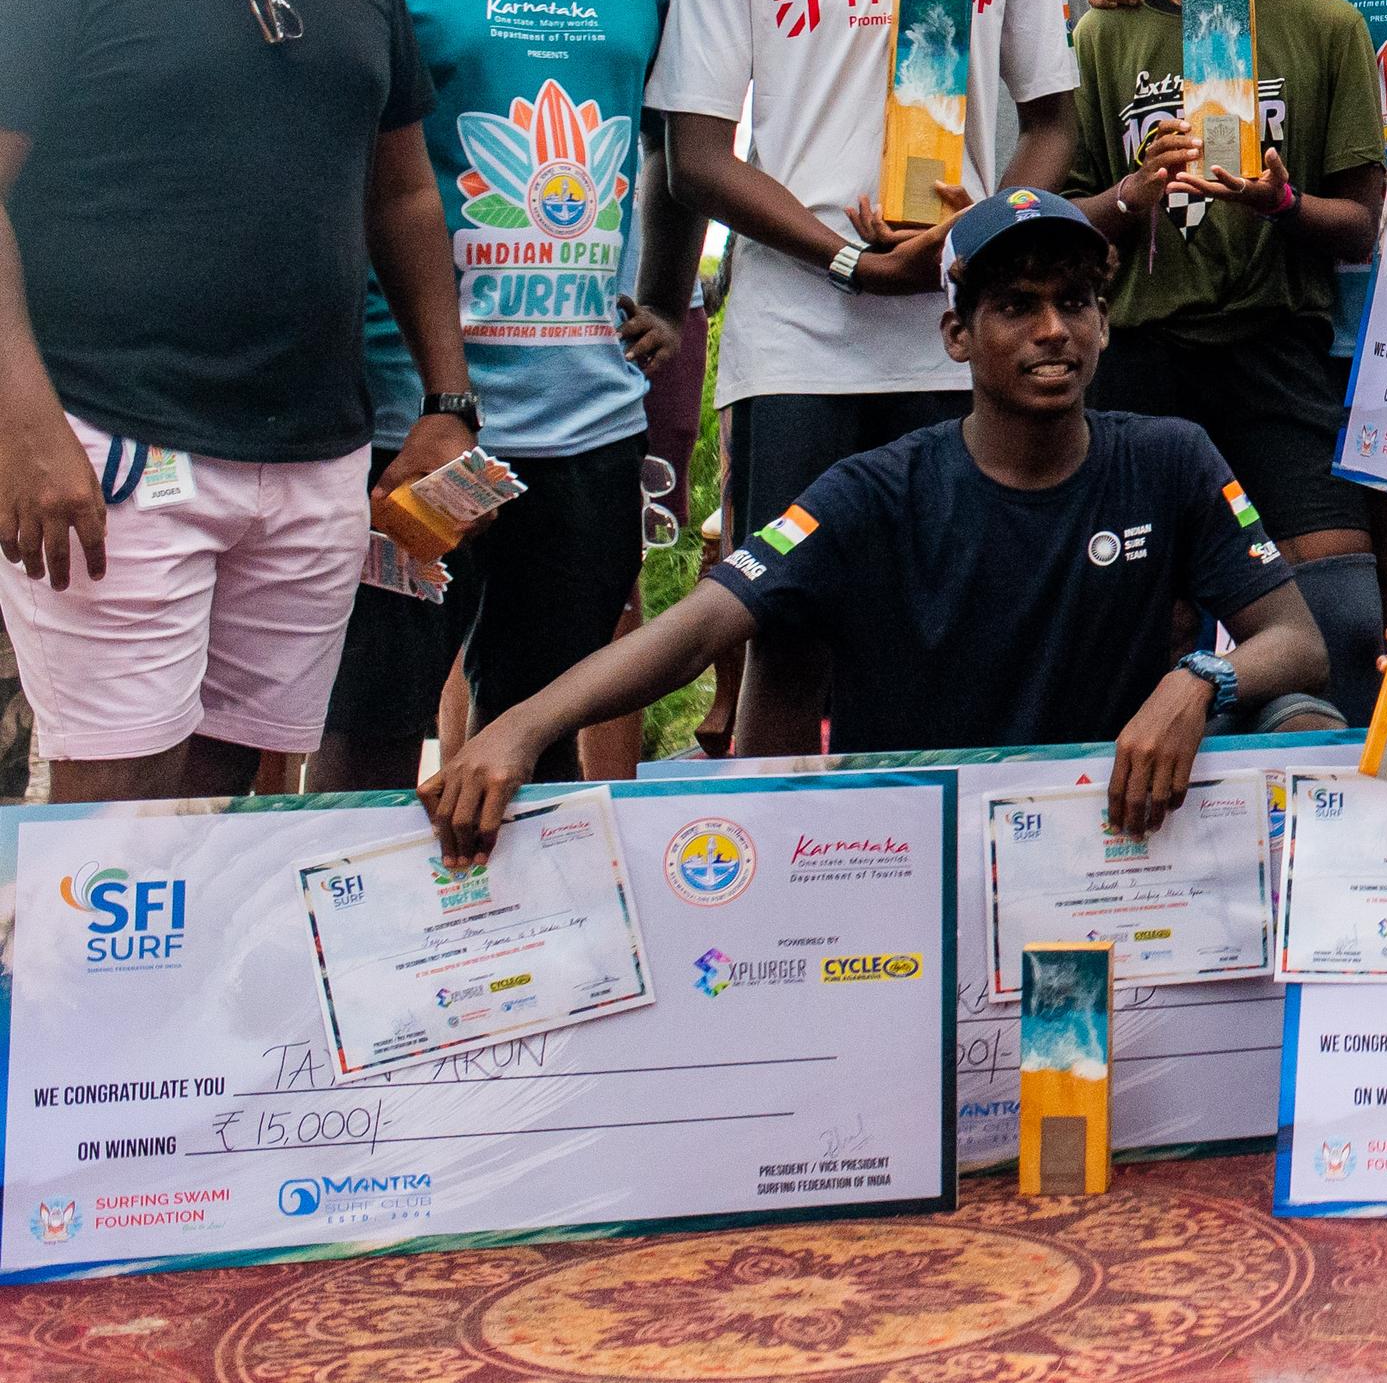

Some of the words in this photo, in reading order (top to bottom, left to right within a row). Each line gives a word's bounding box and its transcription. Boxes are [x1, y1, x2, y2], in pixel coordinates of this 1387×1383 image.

[151, 487, 182, 500] JUDGES
[88, 879, 186, 934] SFI
[86, 933, 185, 962] SURF
[1320, 1035, 1341, 1052] WE
[34, 1087, 59, 1108] WE
[63, 1079, 192, 1104] CONGRATULATE
[195, 1077, 226, 1097] YOU
[1354, 1088, 1373, 1106] ON
[77, 1141, 100, 1161] ON
[104, 1136, 177, 1160] WINNING
[323, 1173, 432, 1195] MANTRA
[95, 1191, 170, 1211] SURFING
[173, 1188, 231, 1205] SWAMI
[94, 1210, 205, 1229] FOUNDATION
